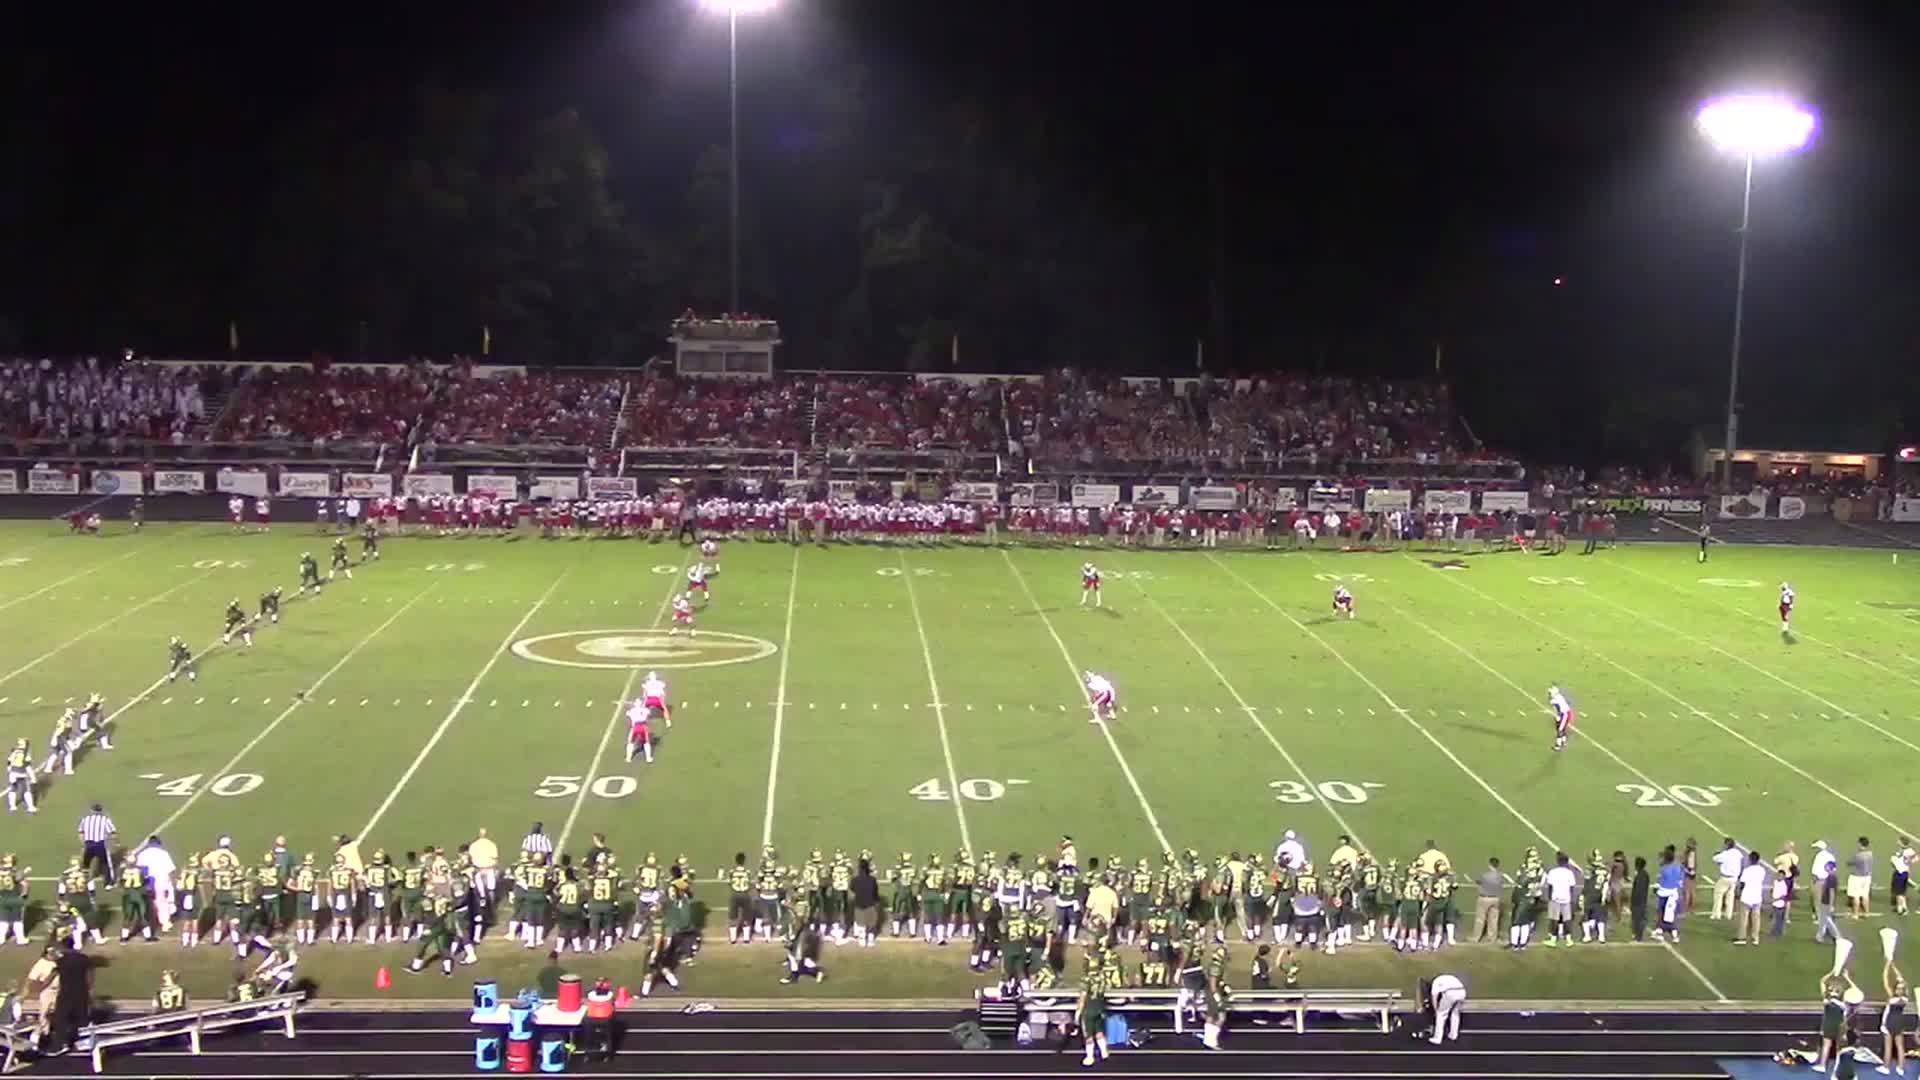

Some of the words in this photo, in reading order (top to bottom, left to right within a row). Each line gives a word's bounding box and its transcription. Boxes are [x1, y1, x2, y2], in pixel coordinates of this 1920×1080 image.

[155, 773, 264, 796] 40
[534, 775, 638, 798] 50
[908, 778, 1005, 801] 40
[1268, 780, 1367, 804] 30
[1615, 783, 1722, 807] 20
[1142, 966, 1165, 984] 77
[160, 987, 183, 1009] 87
